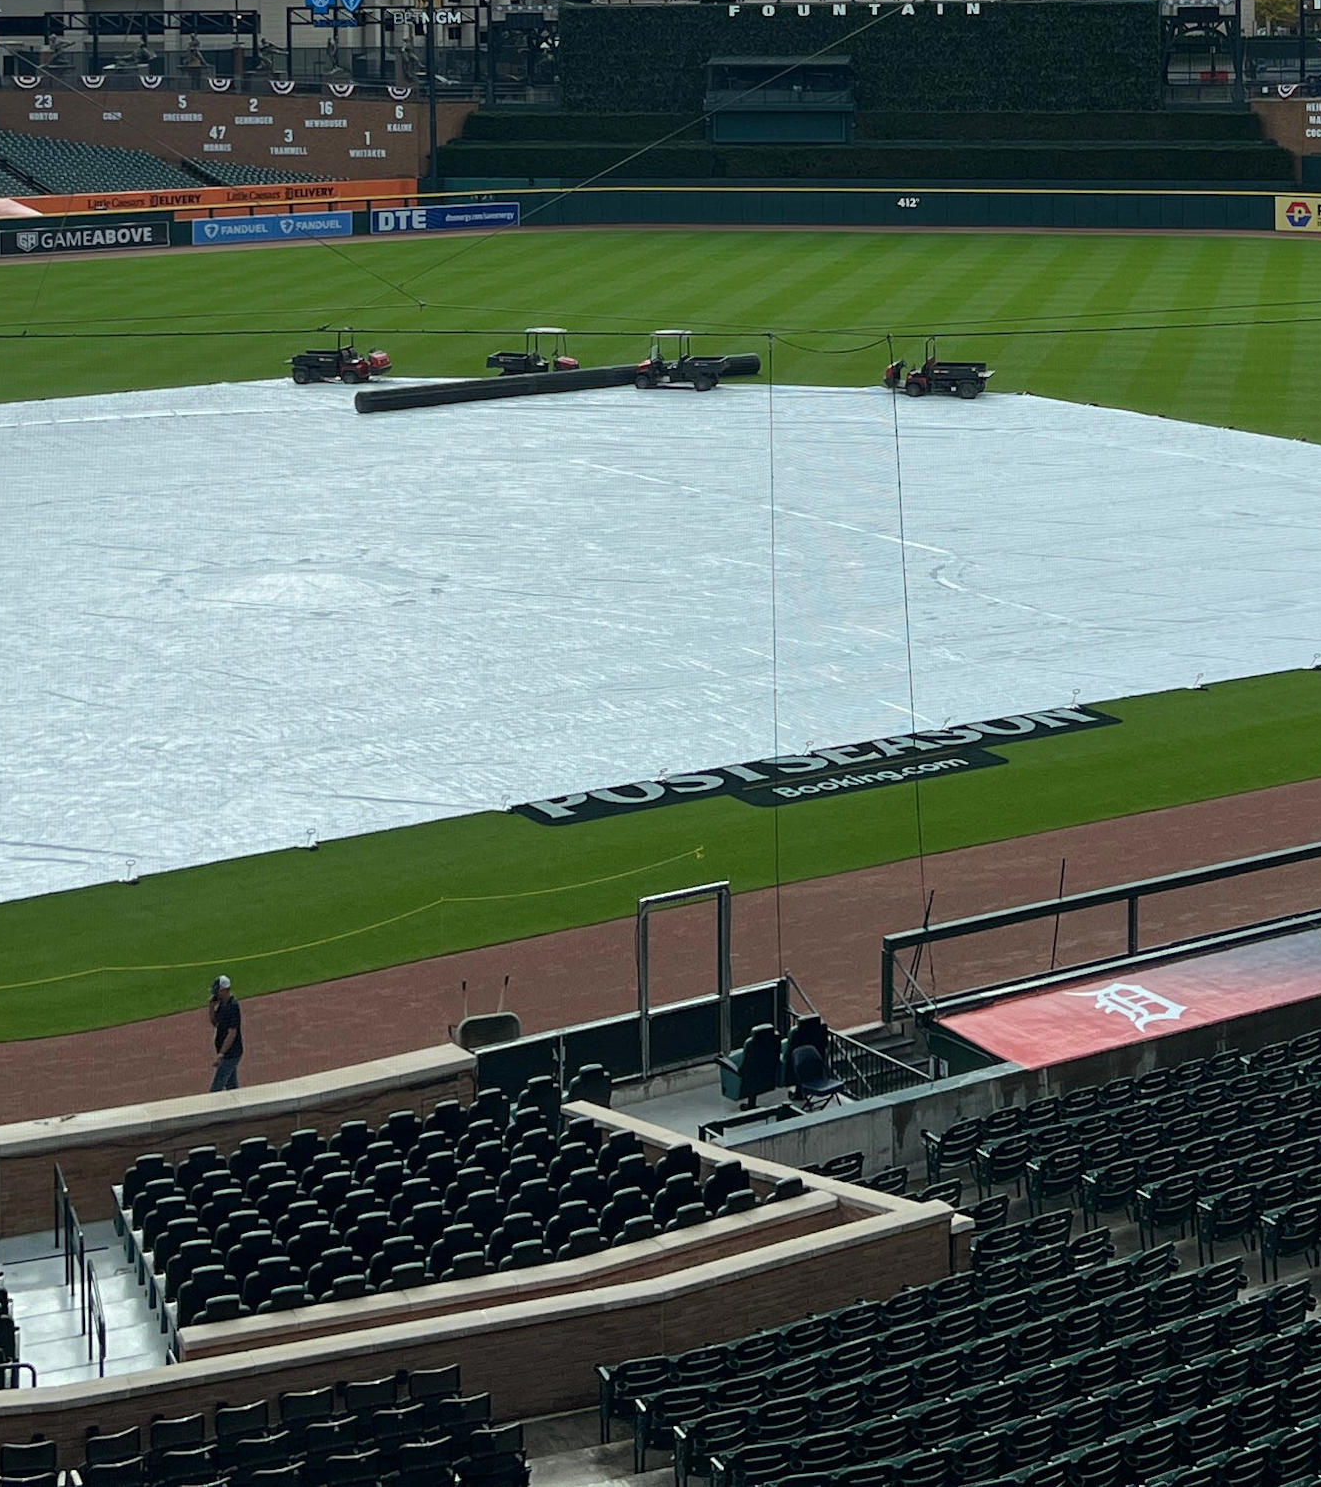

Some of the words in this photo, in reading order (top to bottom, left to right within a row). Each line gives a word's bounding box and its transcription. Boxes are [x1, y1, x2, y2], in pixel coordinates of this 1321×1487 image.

[729, 2, 981, 17] FOUNTAIN
[35, 95, 53, 109] 23
[178, 95, 187, 109] 5
[249, 98, 258, 112] 2
[319, 101, 333, 115] 16
[395, 105, 404, 119] 6
[209, 126, 226, 140] 47
[387, 124, 412, 132] KALINE
[284, 129, 293, 143] 3
[364, 132, 371, 145] 1
[295, 219, 342, 231] FANDUEL
[378, 210, 427, 231] DTE
[220, 223, 268, 236] FANDUEL
[42, 227, 152, 248] GAMEABOVE
[773, 755, 969, 800] Booking.com
